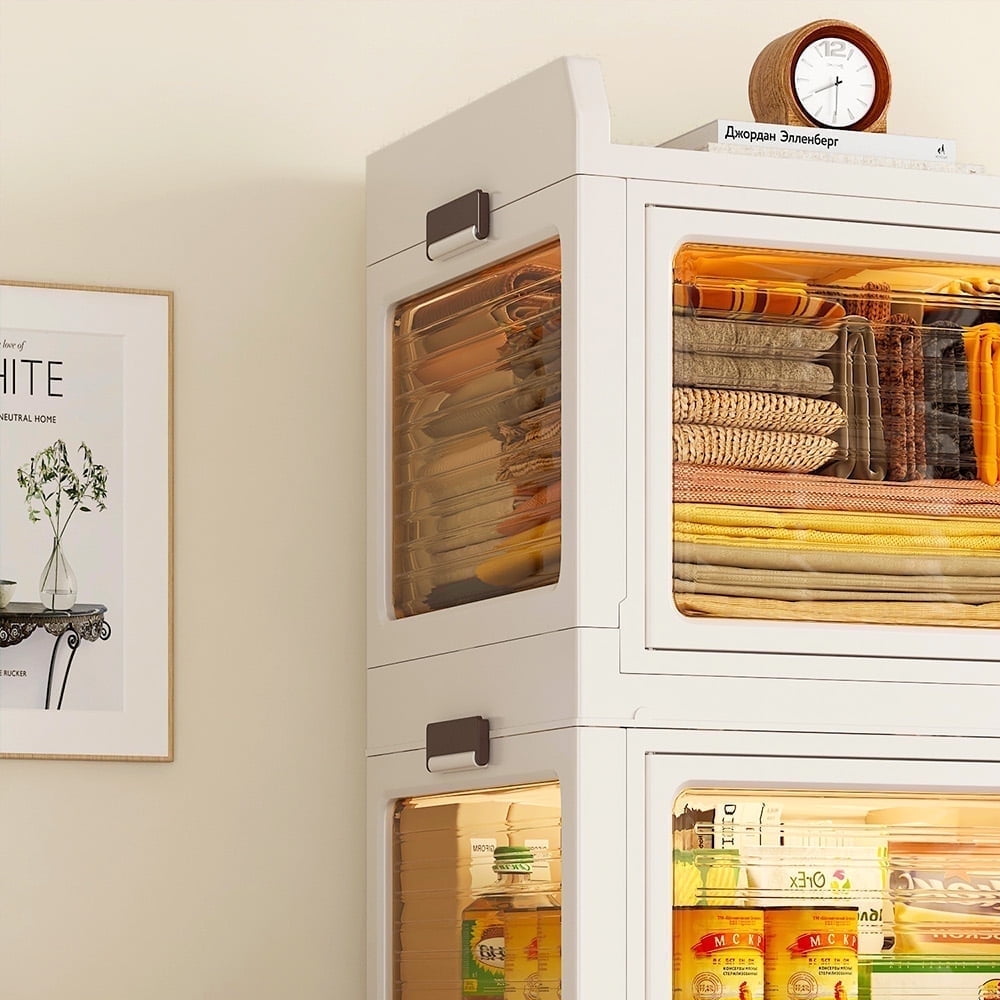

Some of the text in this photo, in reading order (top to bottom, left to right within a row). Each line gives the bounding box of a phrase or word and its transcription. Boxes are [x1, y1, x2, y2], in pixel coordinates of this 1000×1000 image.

[818, 40, 847, 57] 12
[724, 125, 839, 149] Джордан Элленберг
[34, 415, 57, 424] HOME
